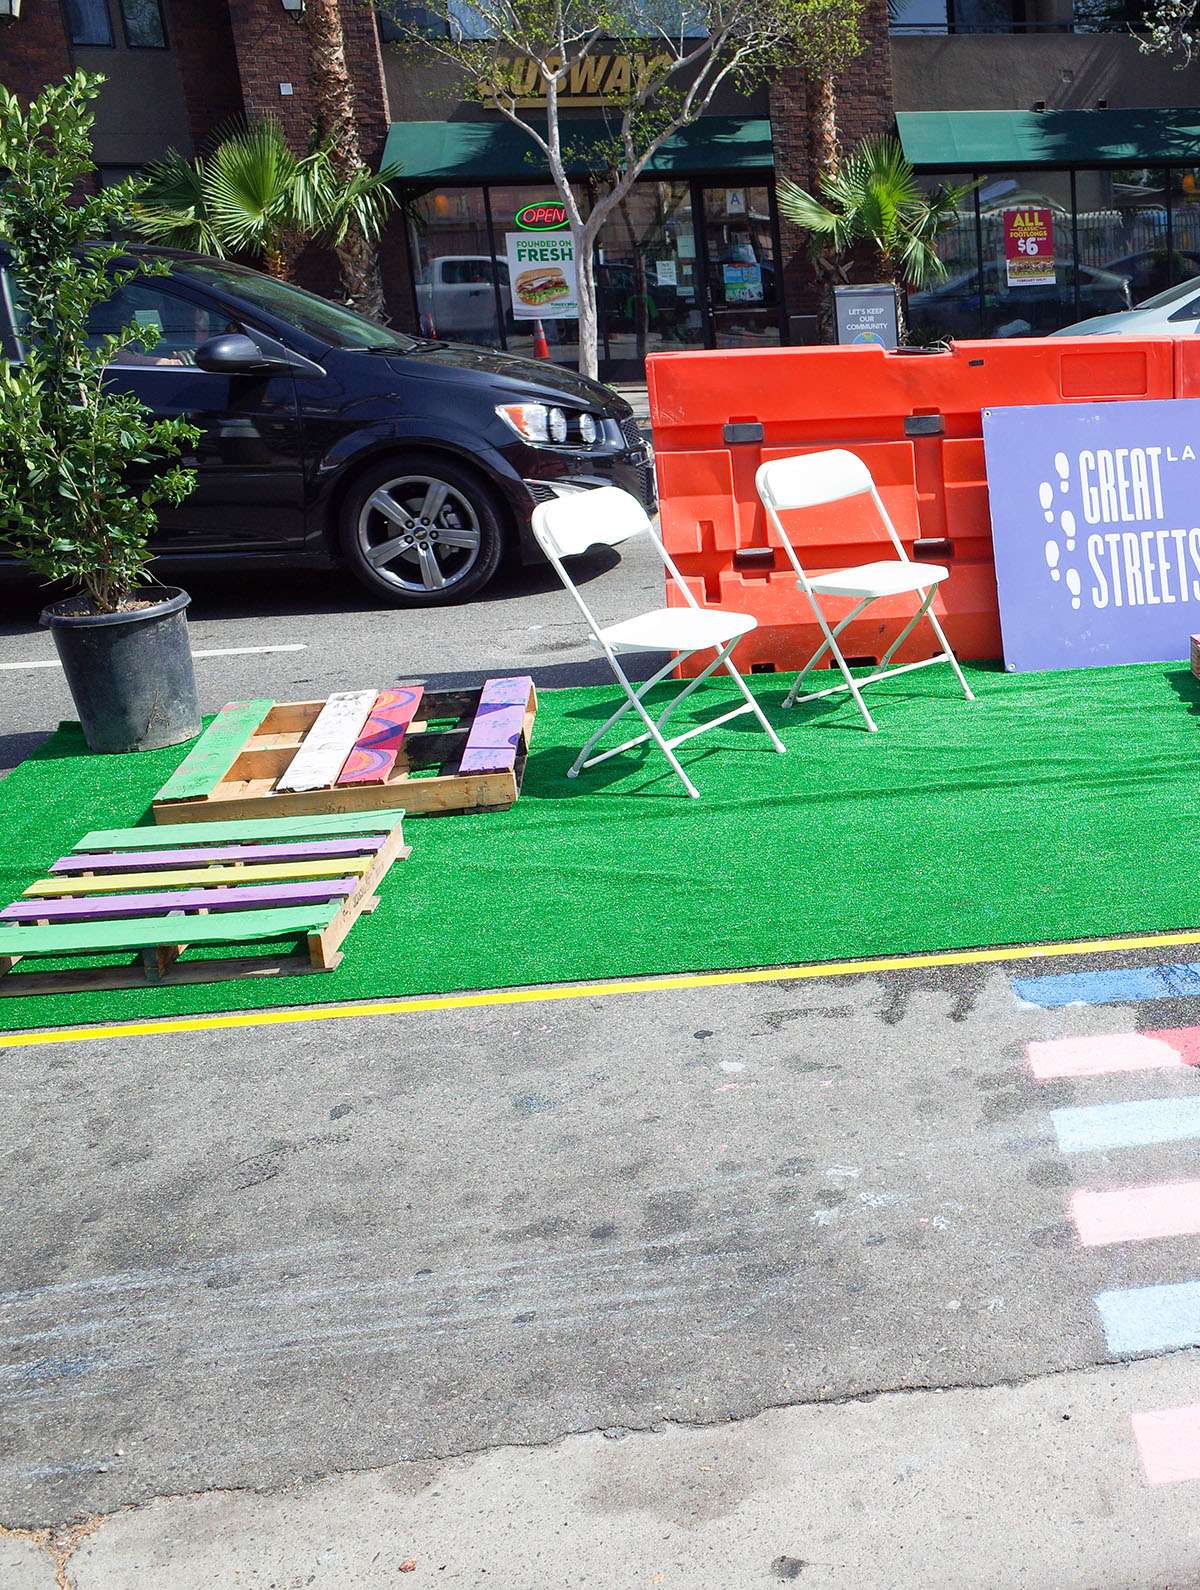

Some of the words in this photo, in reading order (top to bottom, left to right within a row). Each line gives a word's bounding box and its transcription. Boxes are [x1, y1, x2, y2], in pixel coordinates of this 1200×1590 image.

[522, 208, 567, 223] OPEN
[1013, 212, 1044, 227] ALL
[1010, 230, 1048, 238] FOOTLONGS
[516, 240, 557, 248] FOUNDED
[1017, 237, 1040, 256] $6
[517, 247, 574, 262] FRESH
[848, 308, 866, 316] LET'S
[866, 307, 885, 315] KEEP
[846, 322, 888, 331] COMMUNITY
[1079, 447, 1164, 525] GREAT
[1166, 445, 1196, 462] LA
